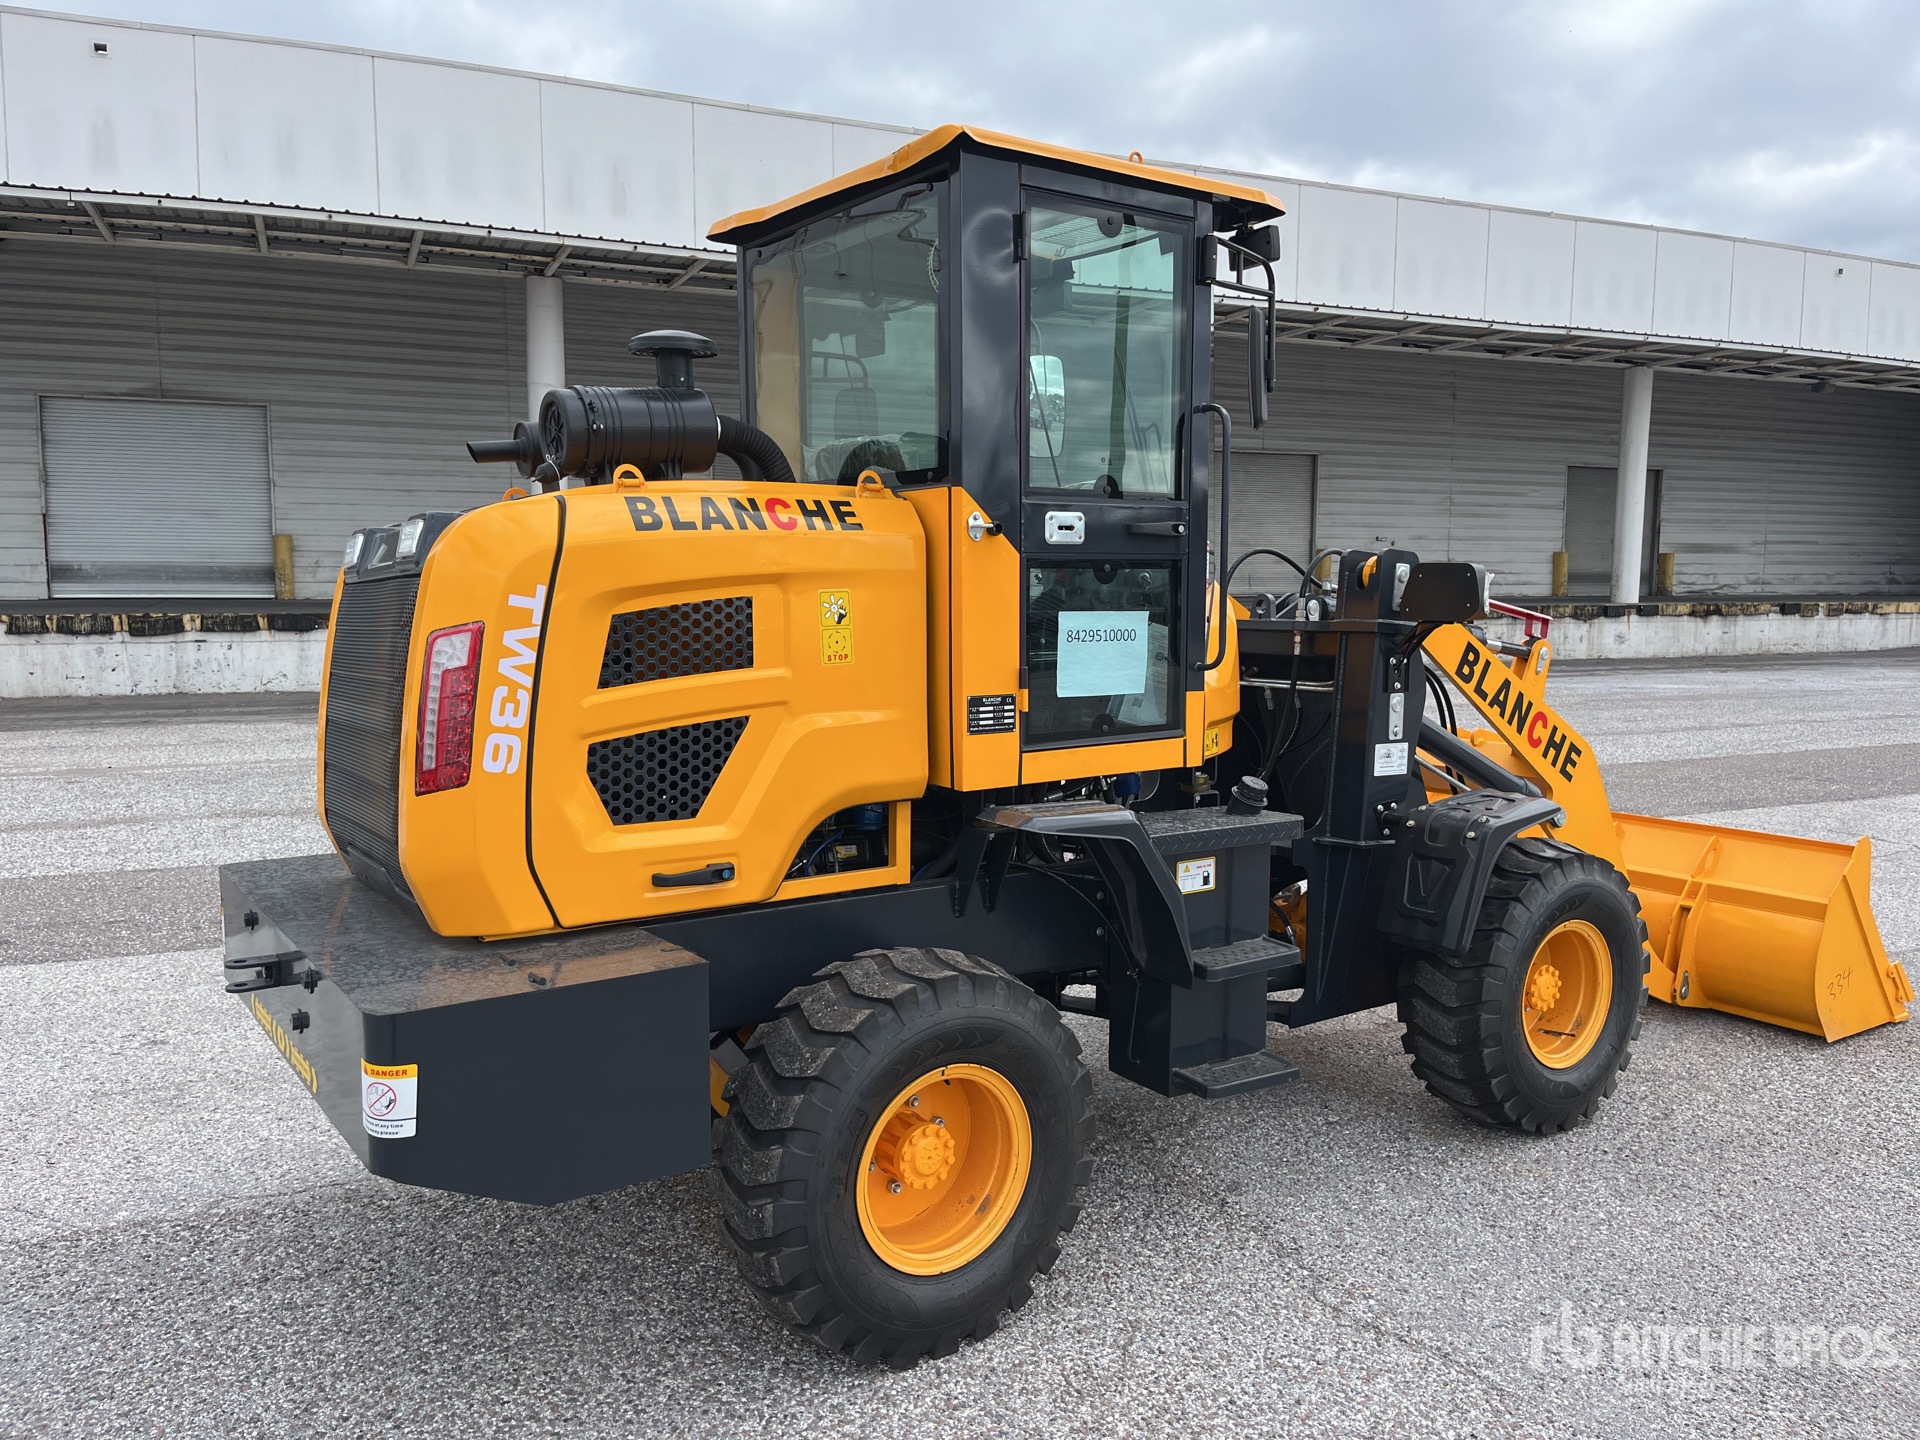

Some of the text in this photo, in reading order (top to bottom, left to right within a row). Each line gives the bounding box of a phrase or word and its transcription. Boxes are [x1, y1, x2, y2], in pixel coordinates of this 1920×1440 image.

[624, 496, 864, 531] BLANCHE
[1066, 628, 1137, 643] 8429510000
[827, 653, 849, 662] STOP
[483, 584, 546, 774] TW36
[1455, 640, 1583, 783] BLANCHE
[1826, 964, 1854, 1001] 334
[370, 1068, 408, 1077] DANGER
